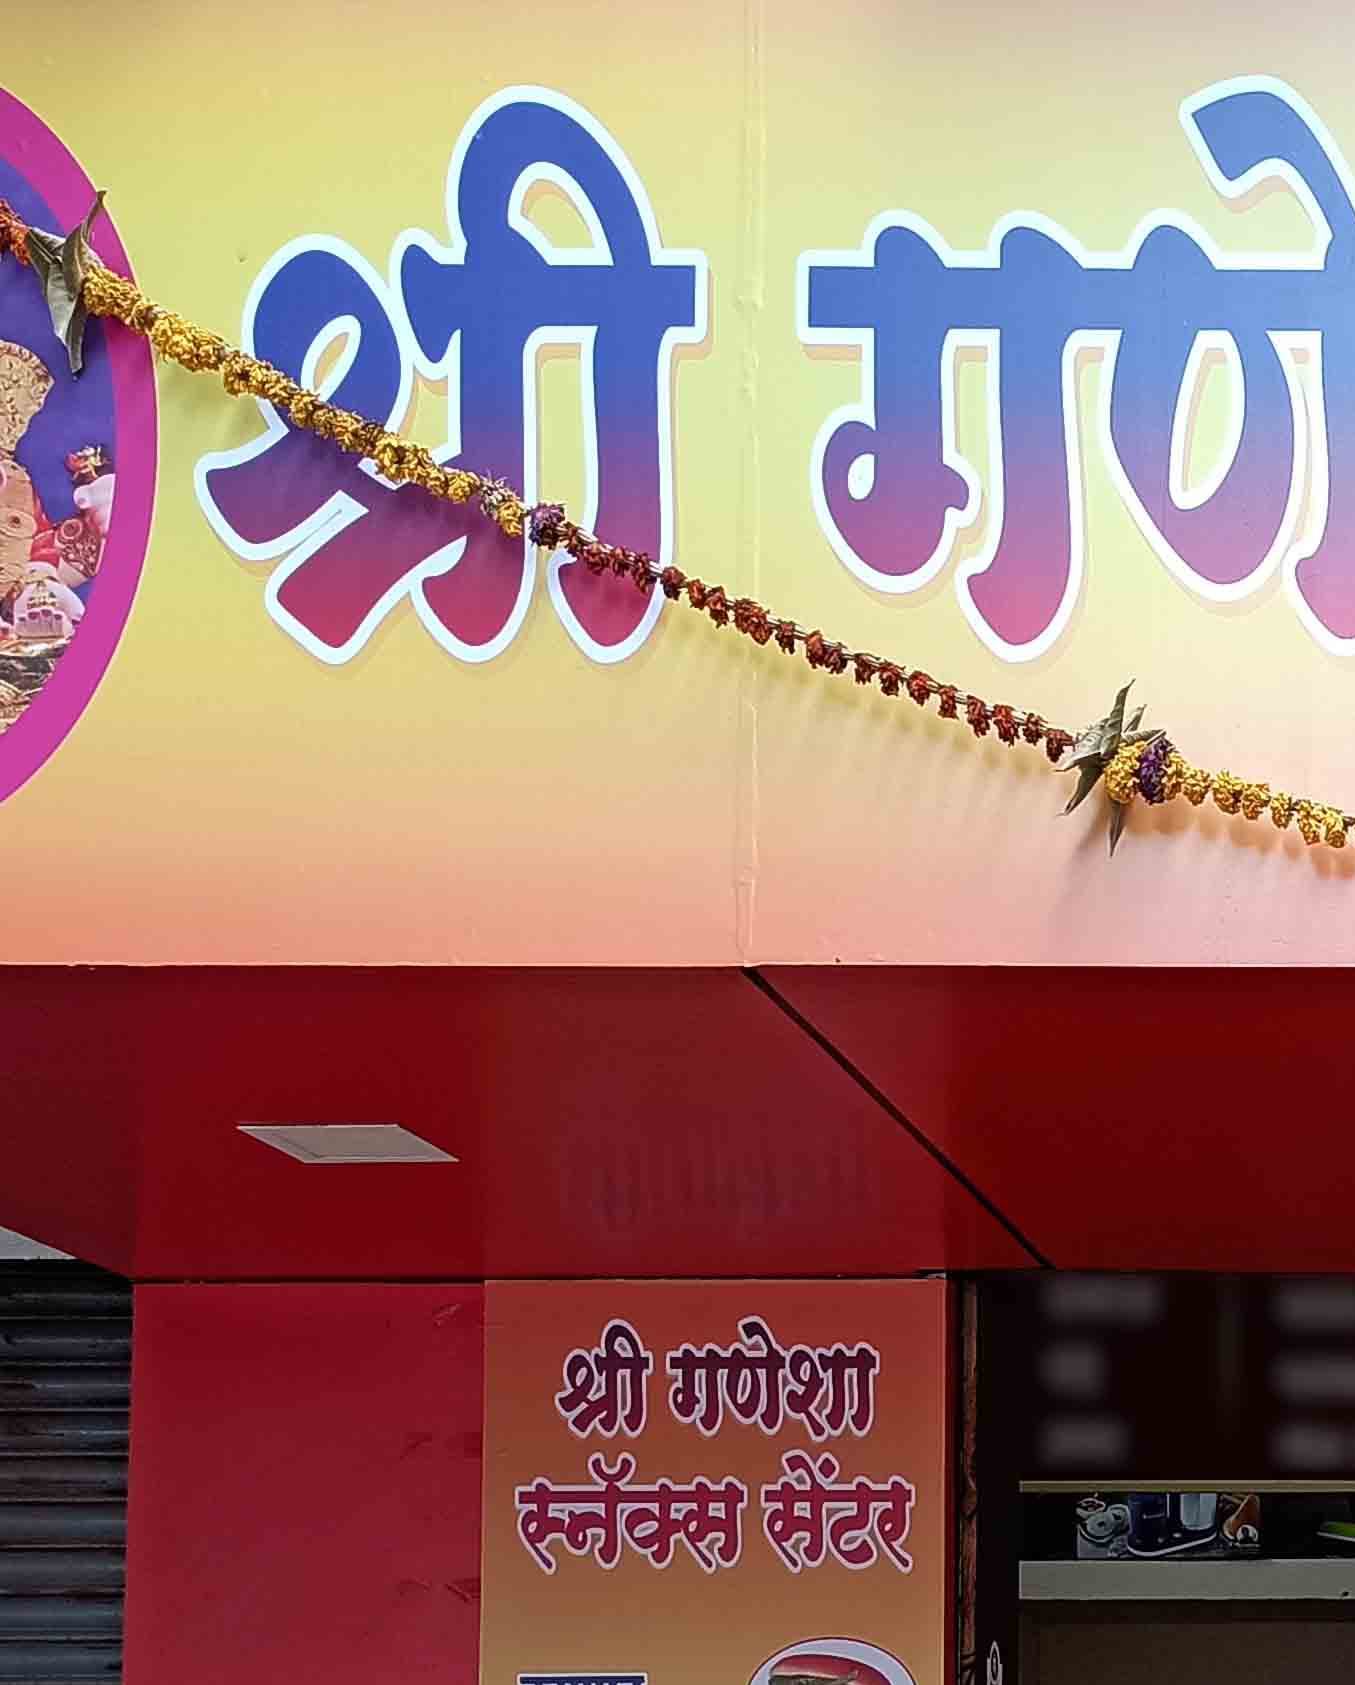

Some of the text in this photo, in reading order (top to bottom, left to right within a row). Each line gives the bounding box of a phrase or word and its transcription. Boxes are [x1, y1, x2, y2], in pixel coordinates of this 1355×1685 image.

[198, 88, 704, 660] श्री
[556, 1315, 879, 1441] श्री गणेशा
[515, 1449, 916, 1573] स्नॅक्स सेंटर
